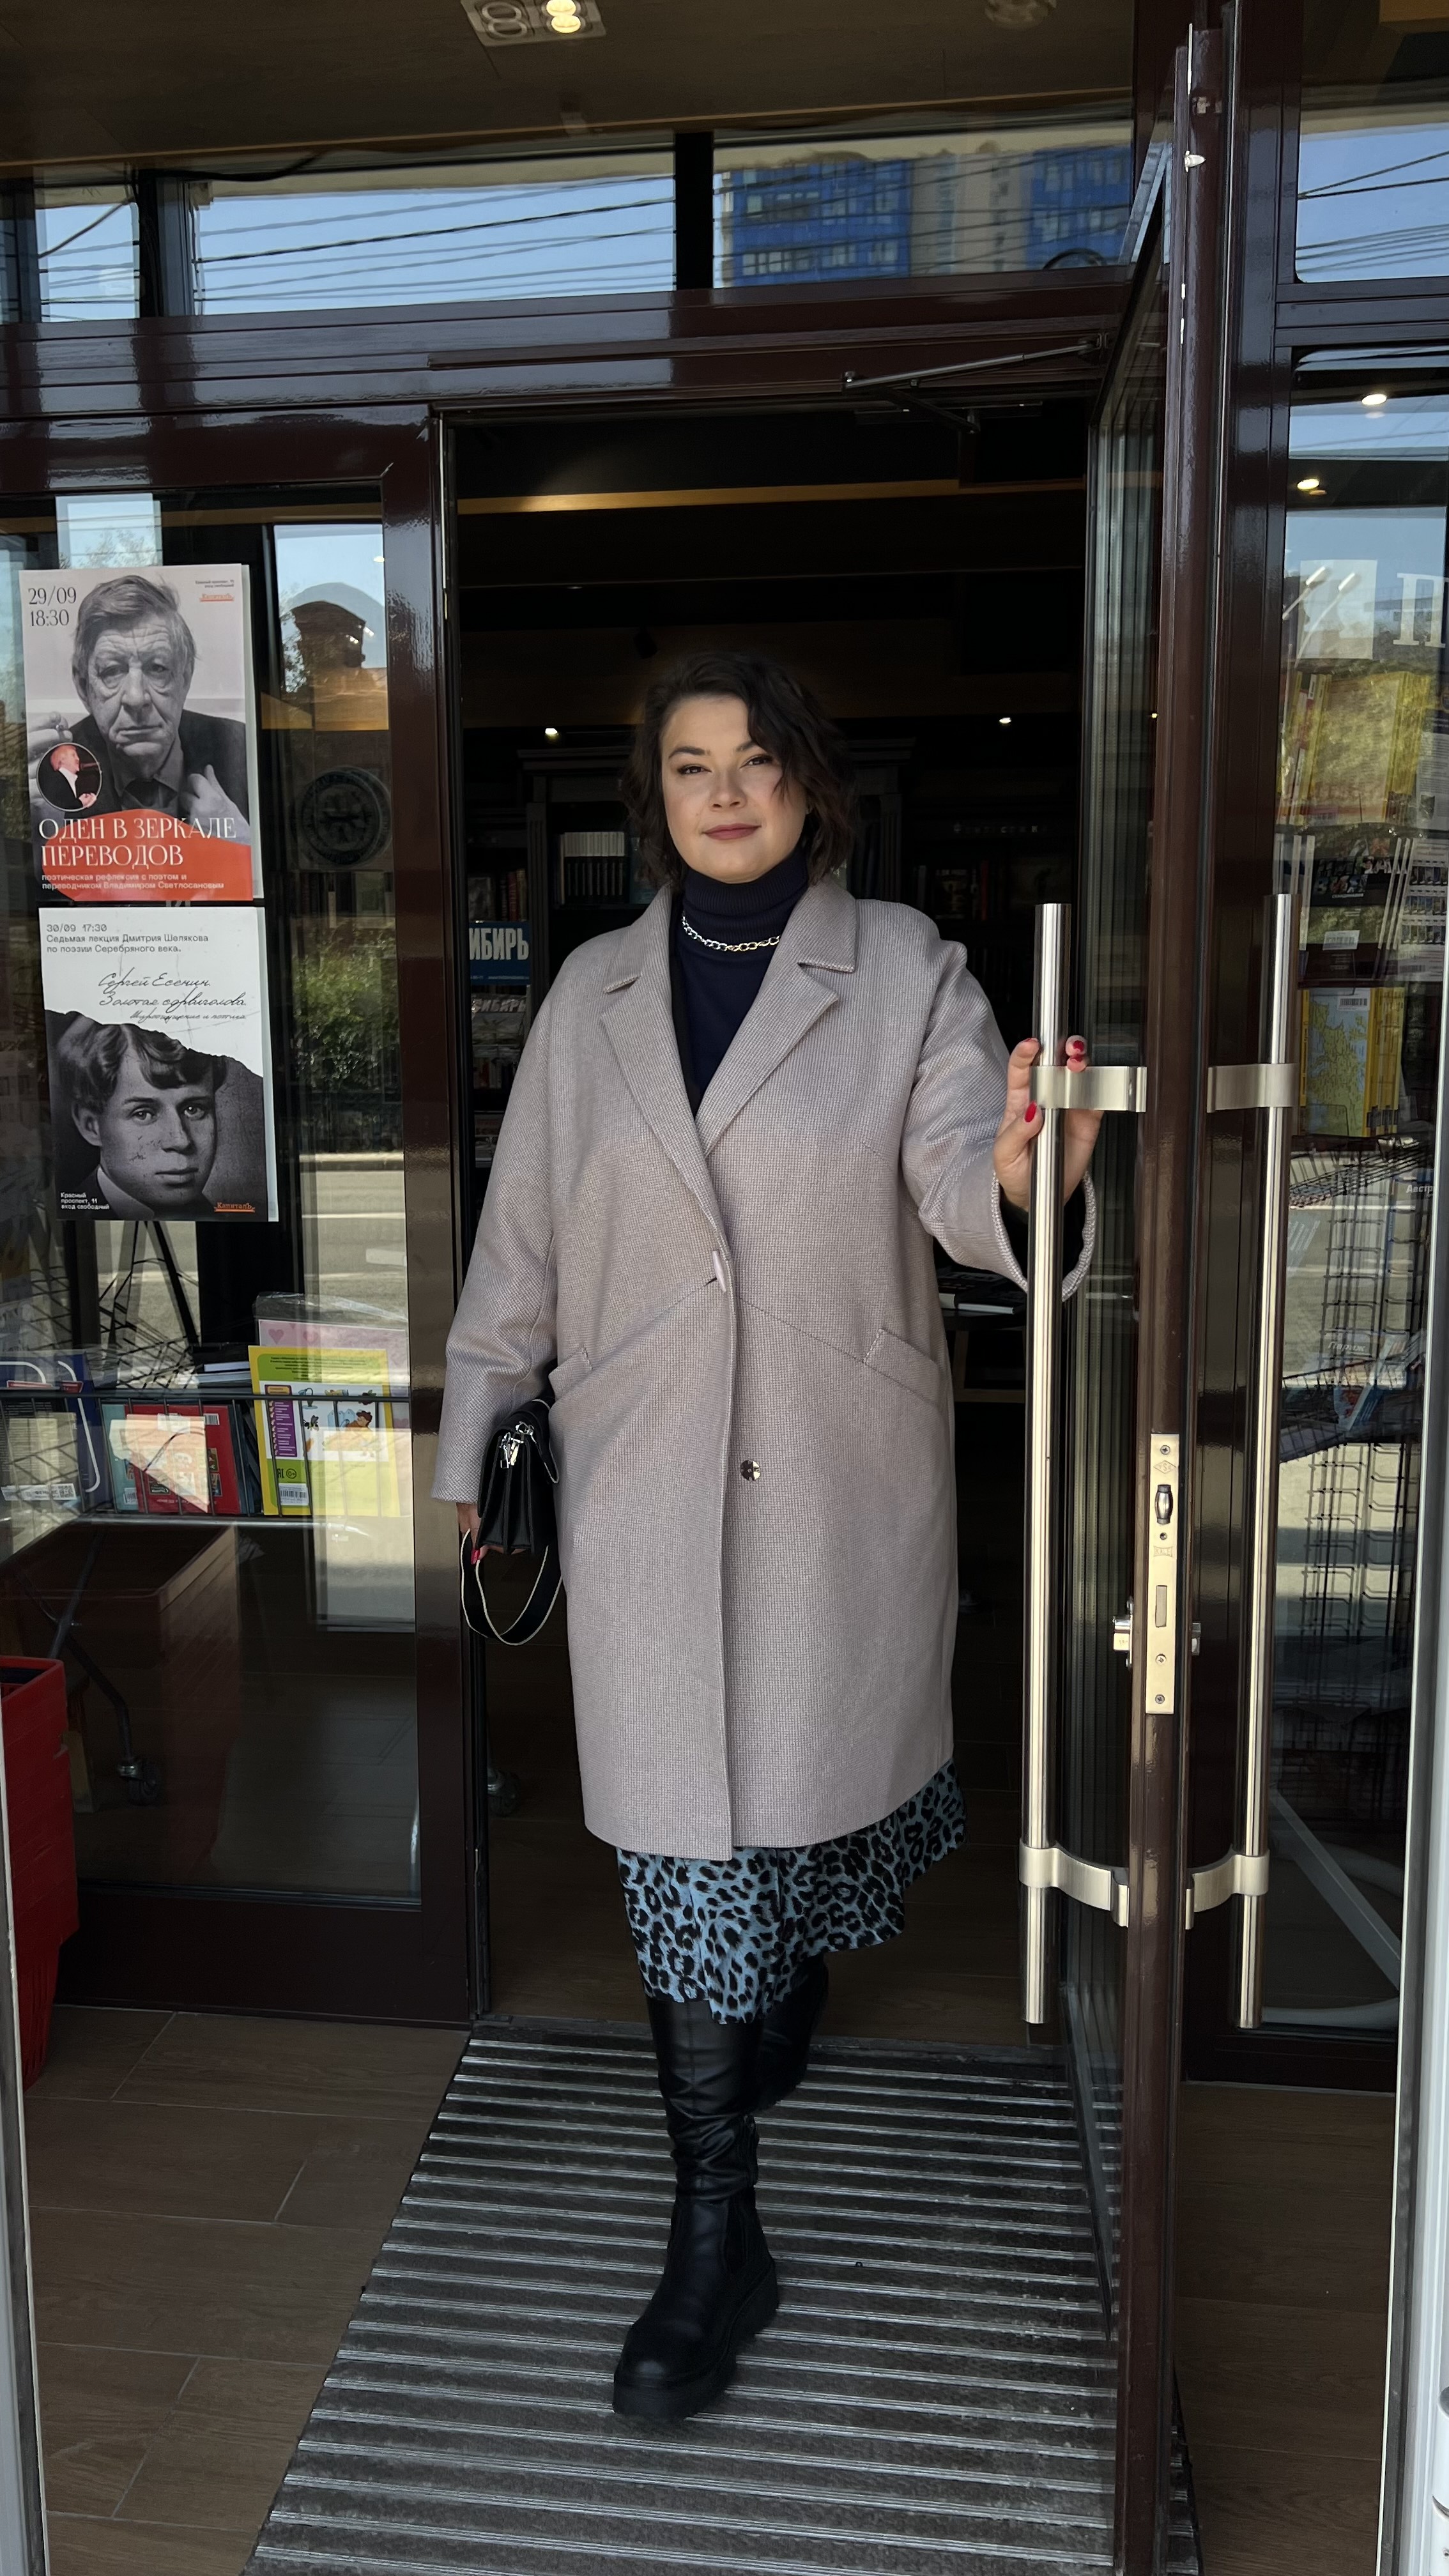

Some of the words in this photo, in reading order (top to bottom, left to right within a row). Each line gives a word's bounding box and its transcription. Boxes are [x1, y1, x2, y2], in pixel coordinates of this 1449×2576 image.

[28, 585, 77, 606] 29/09
[31, 608, 69, 627] 18:30
[39, 817, 105, 843] ОДЕН
[114, 818, 128, 839] В
[133, 817, 236, 839] ЗЕРКАЛЕ
[41, 845, 183, 870] ПЕРЕВОДОВ
[96, 873, 139, 882] рефлексия
[42, 882, 102, 891] переводчиком
[103, 882, 156, 890] Владимиром
[158, 881, 224, 890] Светлосановым
[47, 924, 77, 933] 30/09
[82, 924, 107, 932] 17:30
[47, 935, 86, 943] Седьмая
[122, 934, 162, 944] Дмитрия
[164, 934, 209, 942] Шелякова
[468, 928, 529, 960] ИБИРЬ
[95, 944, 155, 954] Серебряного
[98, 967, 151, 994] Сергей
[99, 992, 160, 1006] Золотая
[1406, 1184, 1435, 1195] Австр
